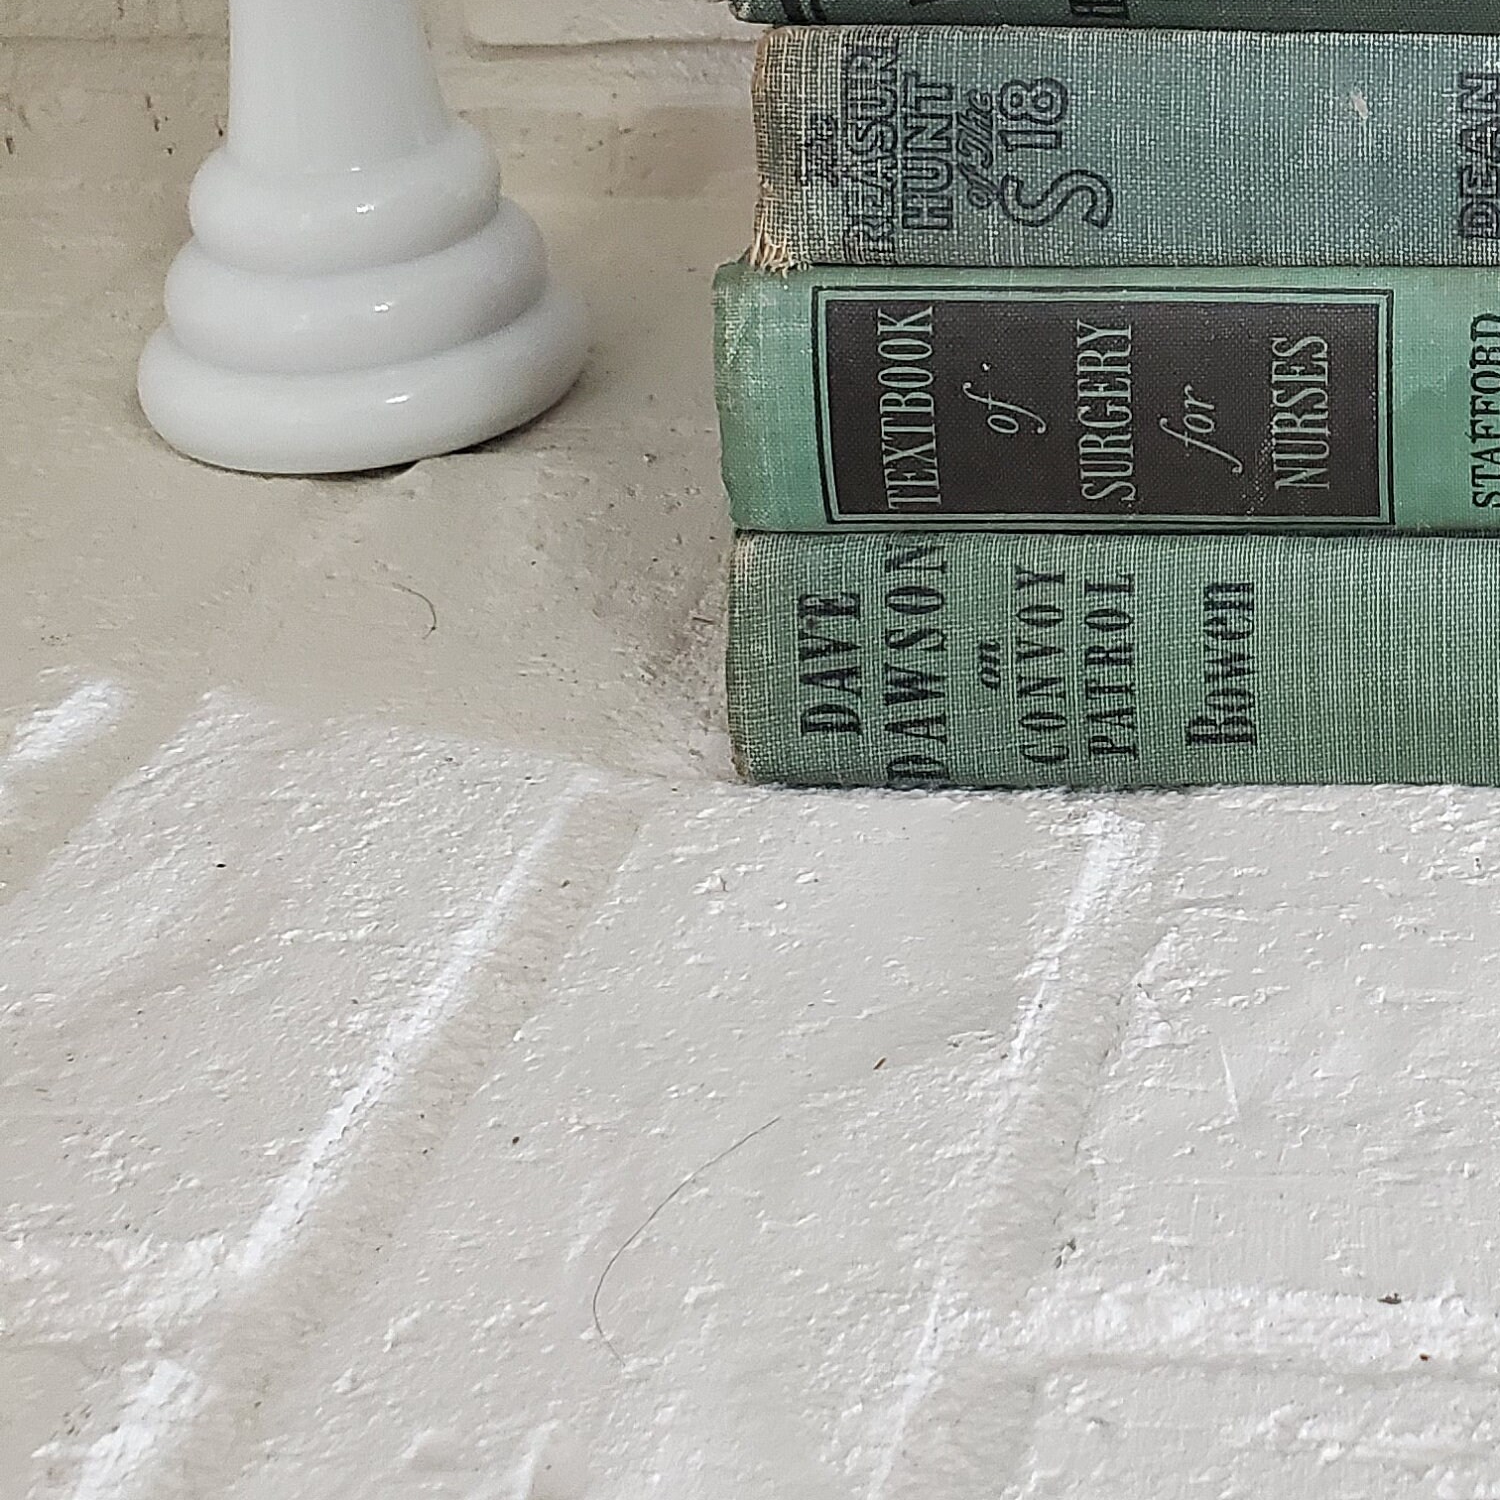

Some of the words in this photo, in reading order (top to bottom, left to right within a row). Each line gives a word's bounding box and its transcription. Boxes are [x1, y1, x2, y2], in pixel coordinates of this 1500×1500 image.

[901, 70, 953, 230] HUNT
[955, 162, 999, 209] of
[877, 305, 942, 510] TEXTBOOK
[962, 381, 1047, 435] of
[1076, 318, 1136, 501] SURGERY
[1160, 384, 1244, 474] for
[1271, 334, 1331, 491] NURSES
[801, 591, 862, 736] DAVE
[884, 541, 949, 780] DAWSON
[975, 640, 1001, 691] on
[1015, 564, 1069, 764] CONVOY
[1084, 572, 1138, 760] PATROL
[1186, 581, 1258, 747] Bowen
